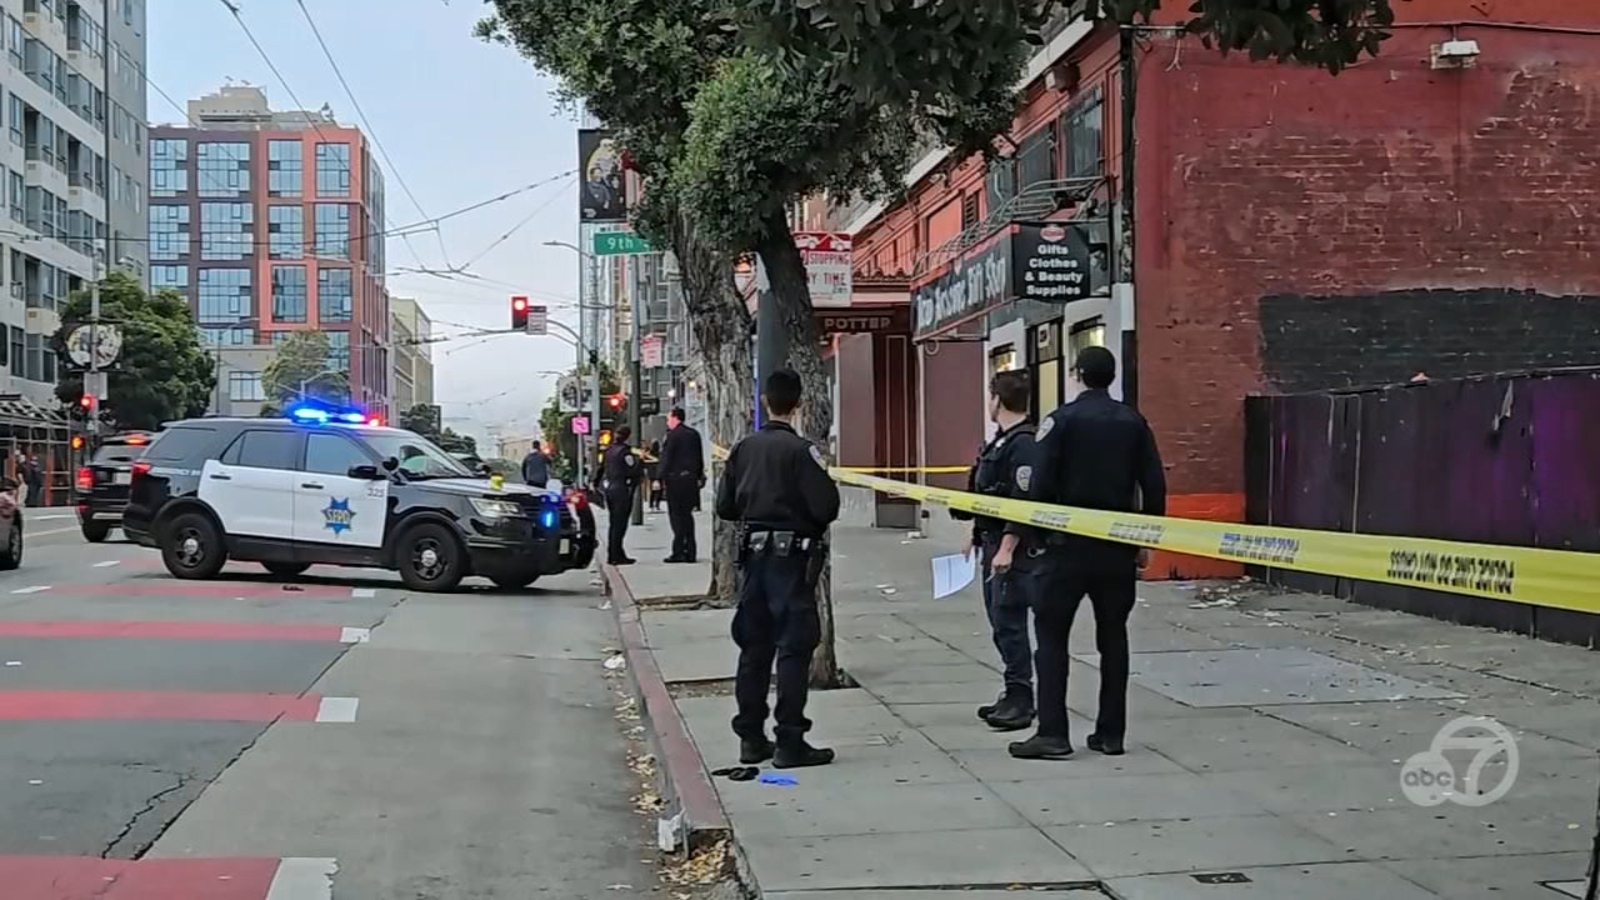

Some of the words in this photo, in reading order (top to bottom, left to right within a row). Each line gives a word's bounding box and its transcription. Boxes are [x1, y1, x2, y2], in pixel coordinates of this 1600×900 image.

[607, 237, 634, 250] 9th
[1037, 244, 1069, 255] Gifts
[1029, 258, 1078, 268] Clothes
[824, 272, 847, 286] TIME
[1025, 271, 1035, 281] &
[1038, 271, 1084, 284] Beauty
[1026, 285, 1081, 297] Supplies
[824, 317, 891, 329] POTTER
